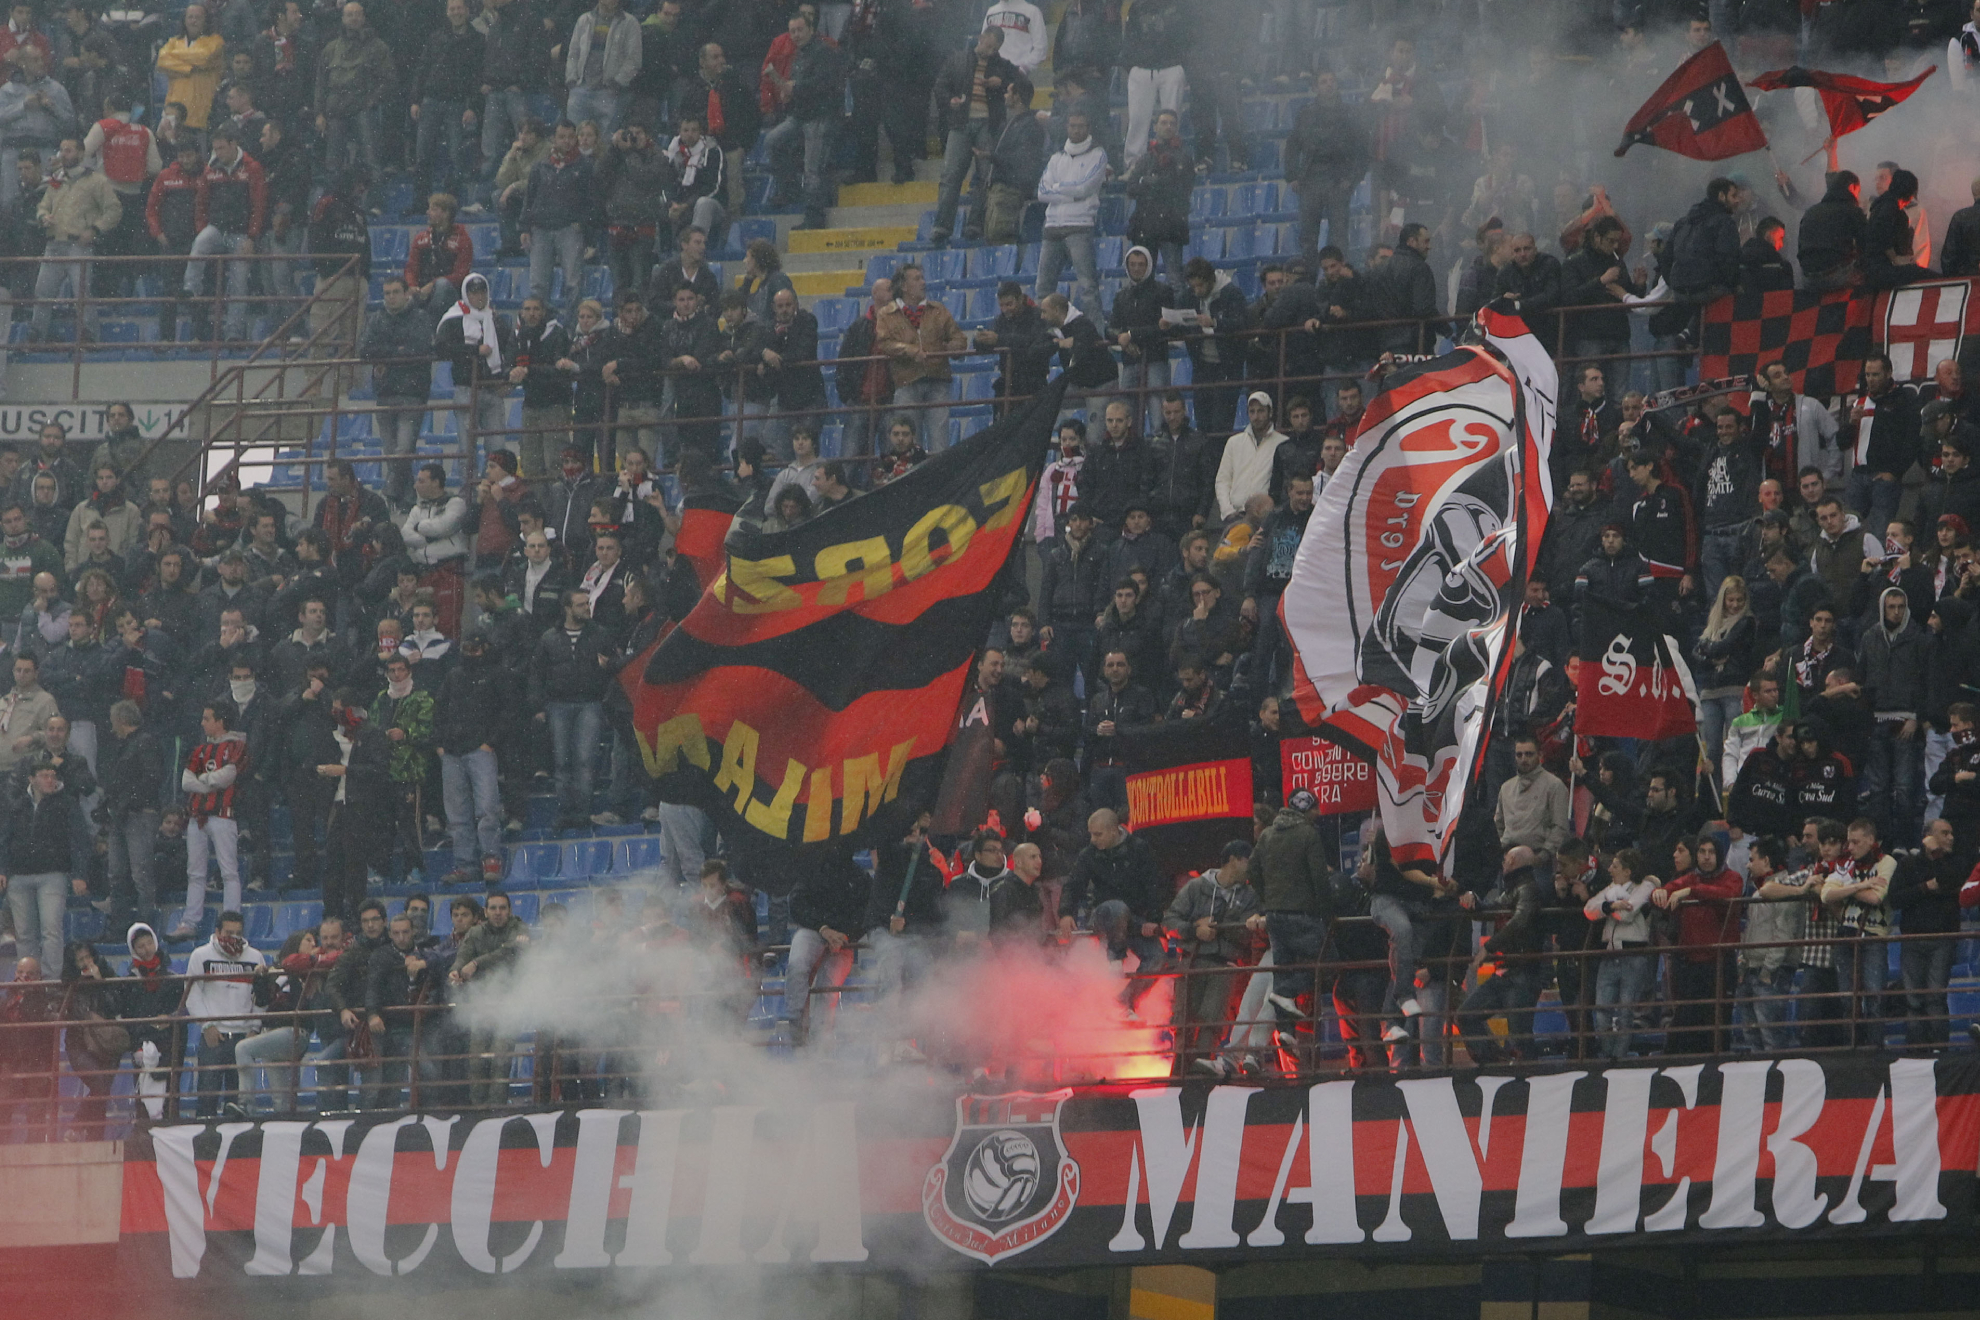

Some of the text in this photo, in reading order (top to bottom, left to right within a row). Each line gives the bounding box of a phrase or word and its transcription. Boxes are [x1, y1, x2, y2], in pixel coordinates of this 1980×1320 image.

[1, 408, 108, 435] USCIT
[149, 1057, 1948, 1279] VECCHIA MANIERA
